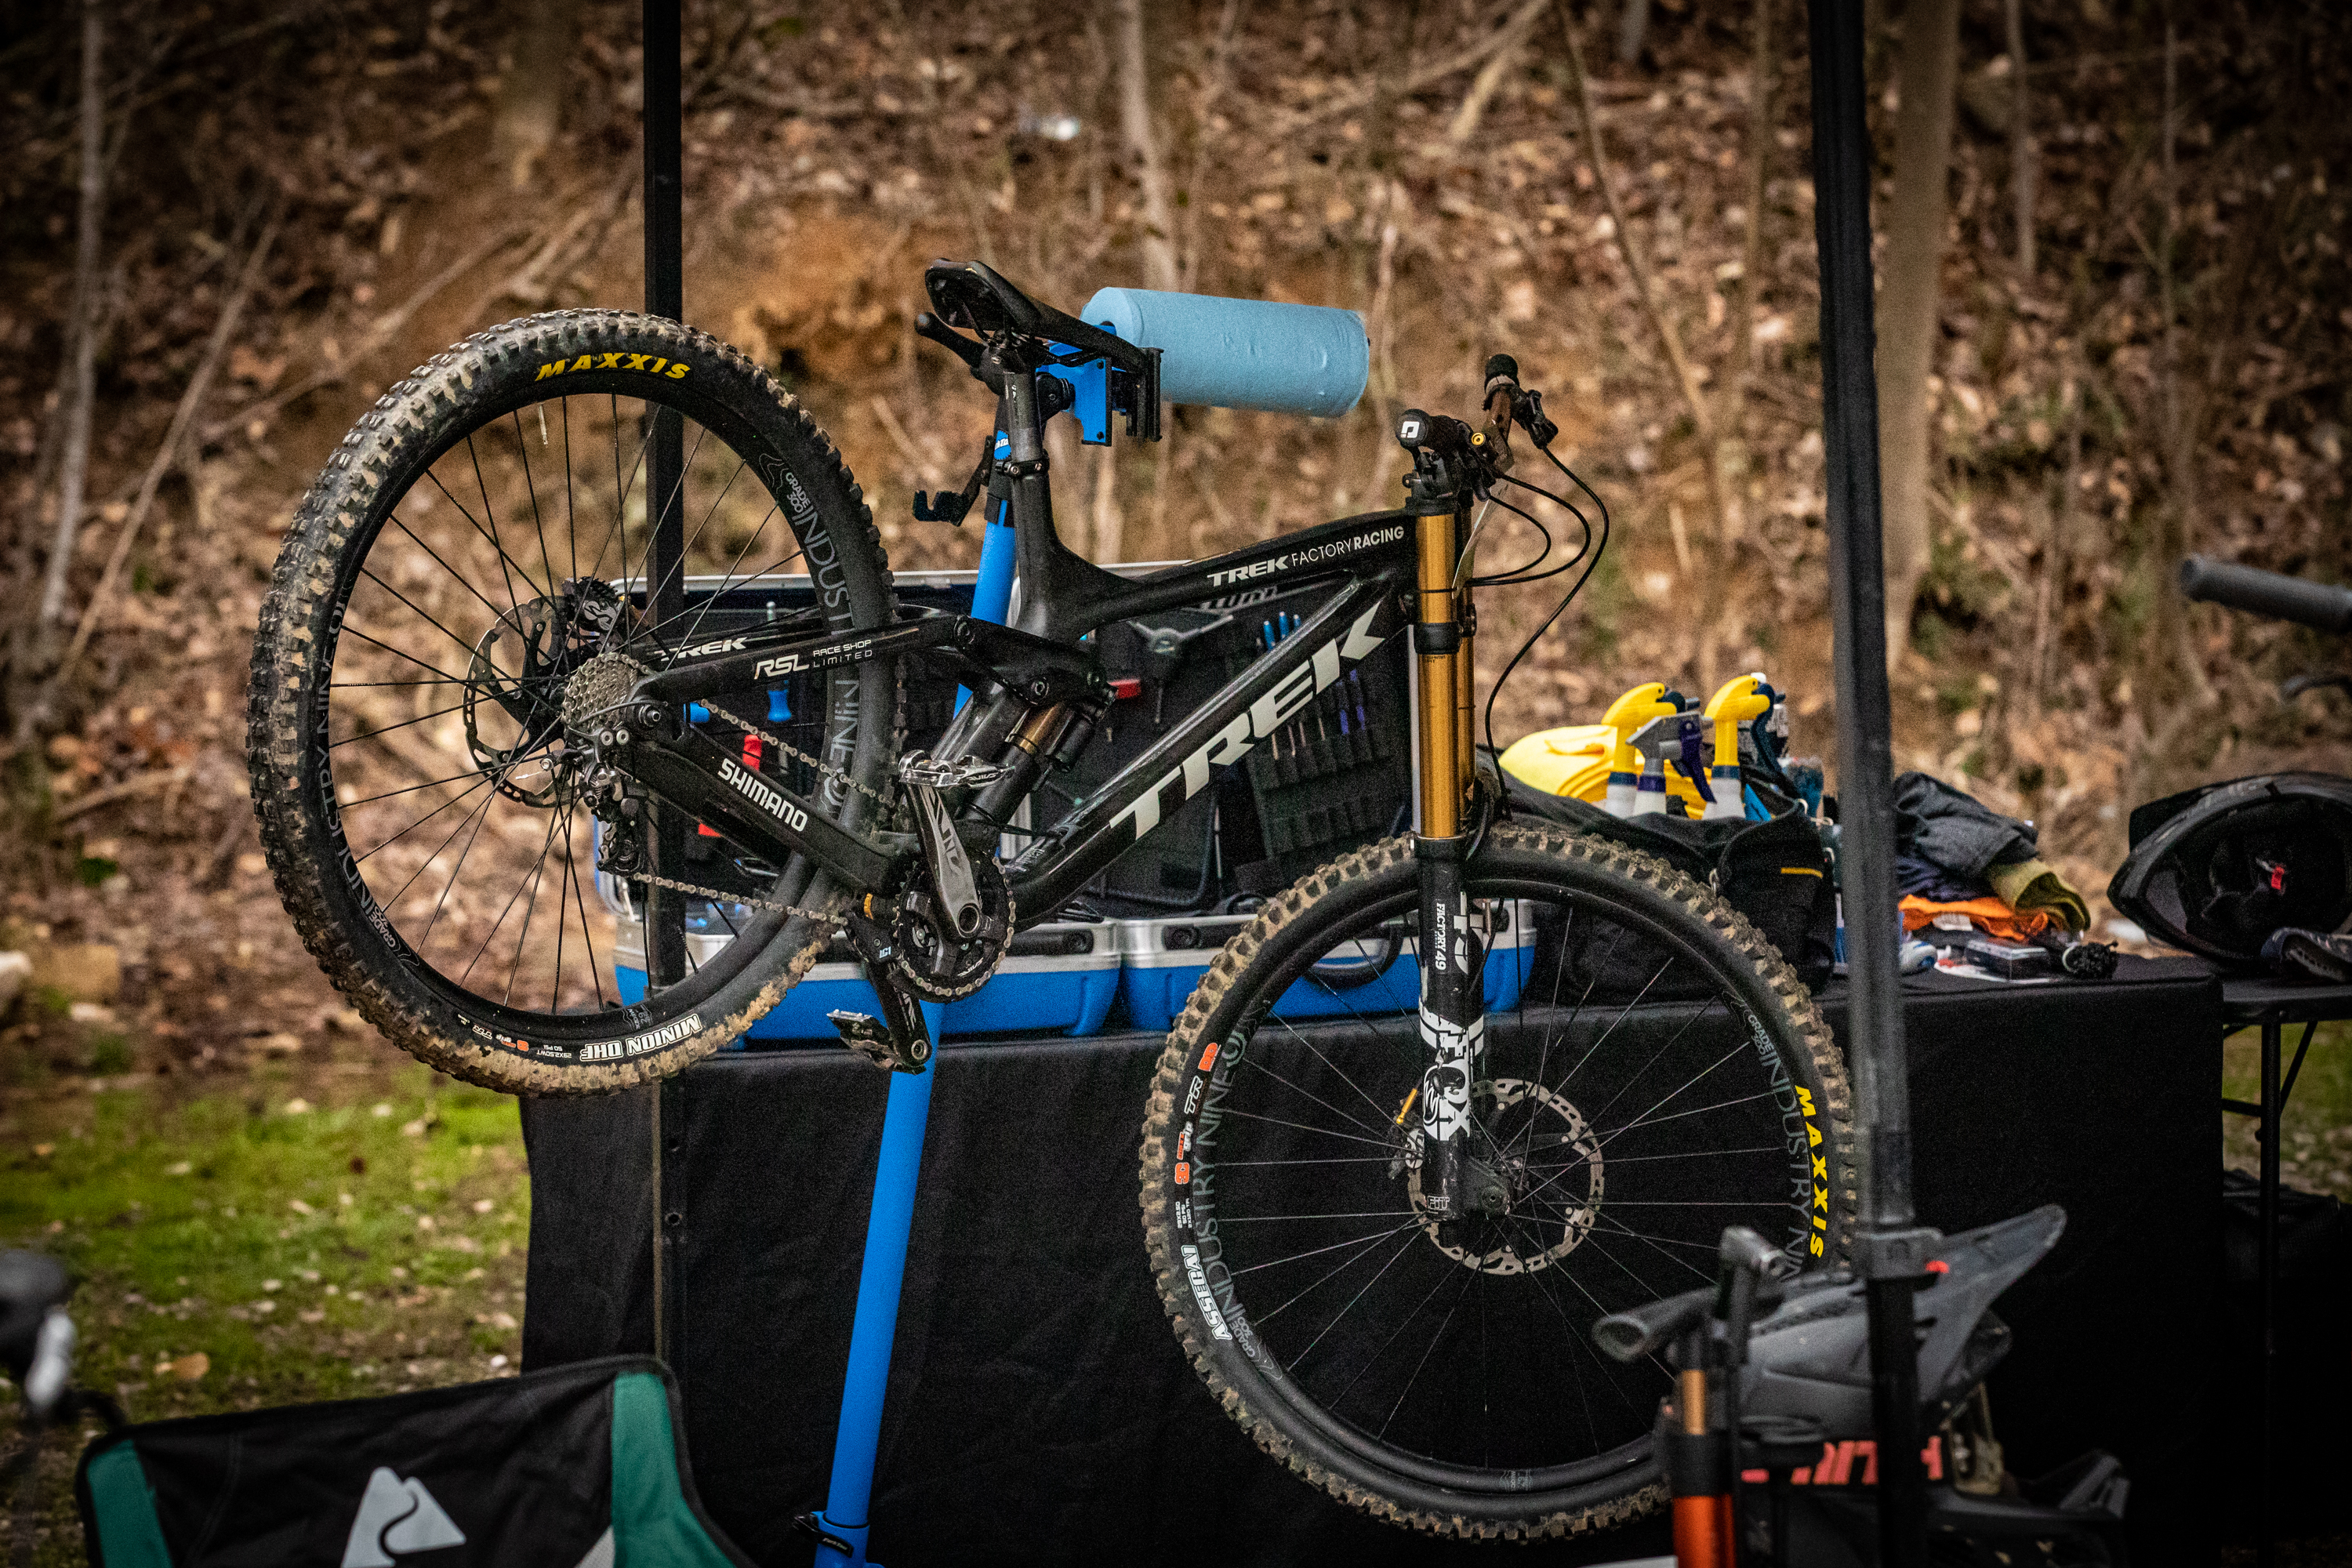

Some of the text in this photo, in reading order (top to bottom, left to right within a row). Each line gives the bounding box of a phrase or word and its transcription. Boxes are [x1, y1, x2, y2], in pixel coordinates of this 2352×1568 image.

[535, 352, 691, 382] MAXXIS
[786, 472, 811, 507] GRADE
[786, 491, 804, 513] 300
[792, 506, 856, 637] INDUST
[1207, 526, 1405, 588] TREK FACTORY RACING
[753, 654, 810, 680] RSL
[813, 639, 873, 657] RACE SHOP
[813, 649, 873, 667] LIMITED
[1109, 600, 1386, 840] TREK
[717, 757, 808, 832] SHIMANO
[368, 910, 397, 948] GRADE
[1435, 902, 1446, 971] FACTORY 49
[579, 1040, 624, 1062] DHF
[626, 1014, 703, 1056] MINION
[1748, 1014, 1776, 1052] GRADE
[1184, 1075, 1203, 1115] TR
[1183, 1121, 1194, 1152] grip
[1759, 1051, 1812, 1219] INDUSTRY
[1795, 1085, 1828, 1258] MAXXIS
[1192, 1070, 1247, 1322] INDUSTRY NINE
[1181, 1245, 1233, 1340] ASSEGAI
[1229, 1320, 1255, 1358] GRADE
